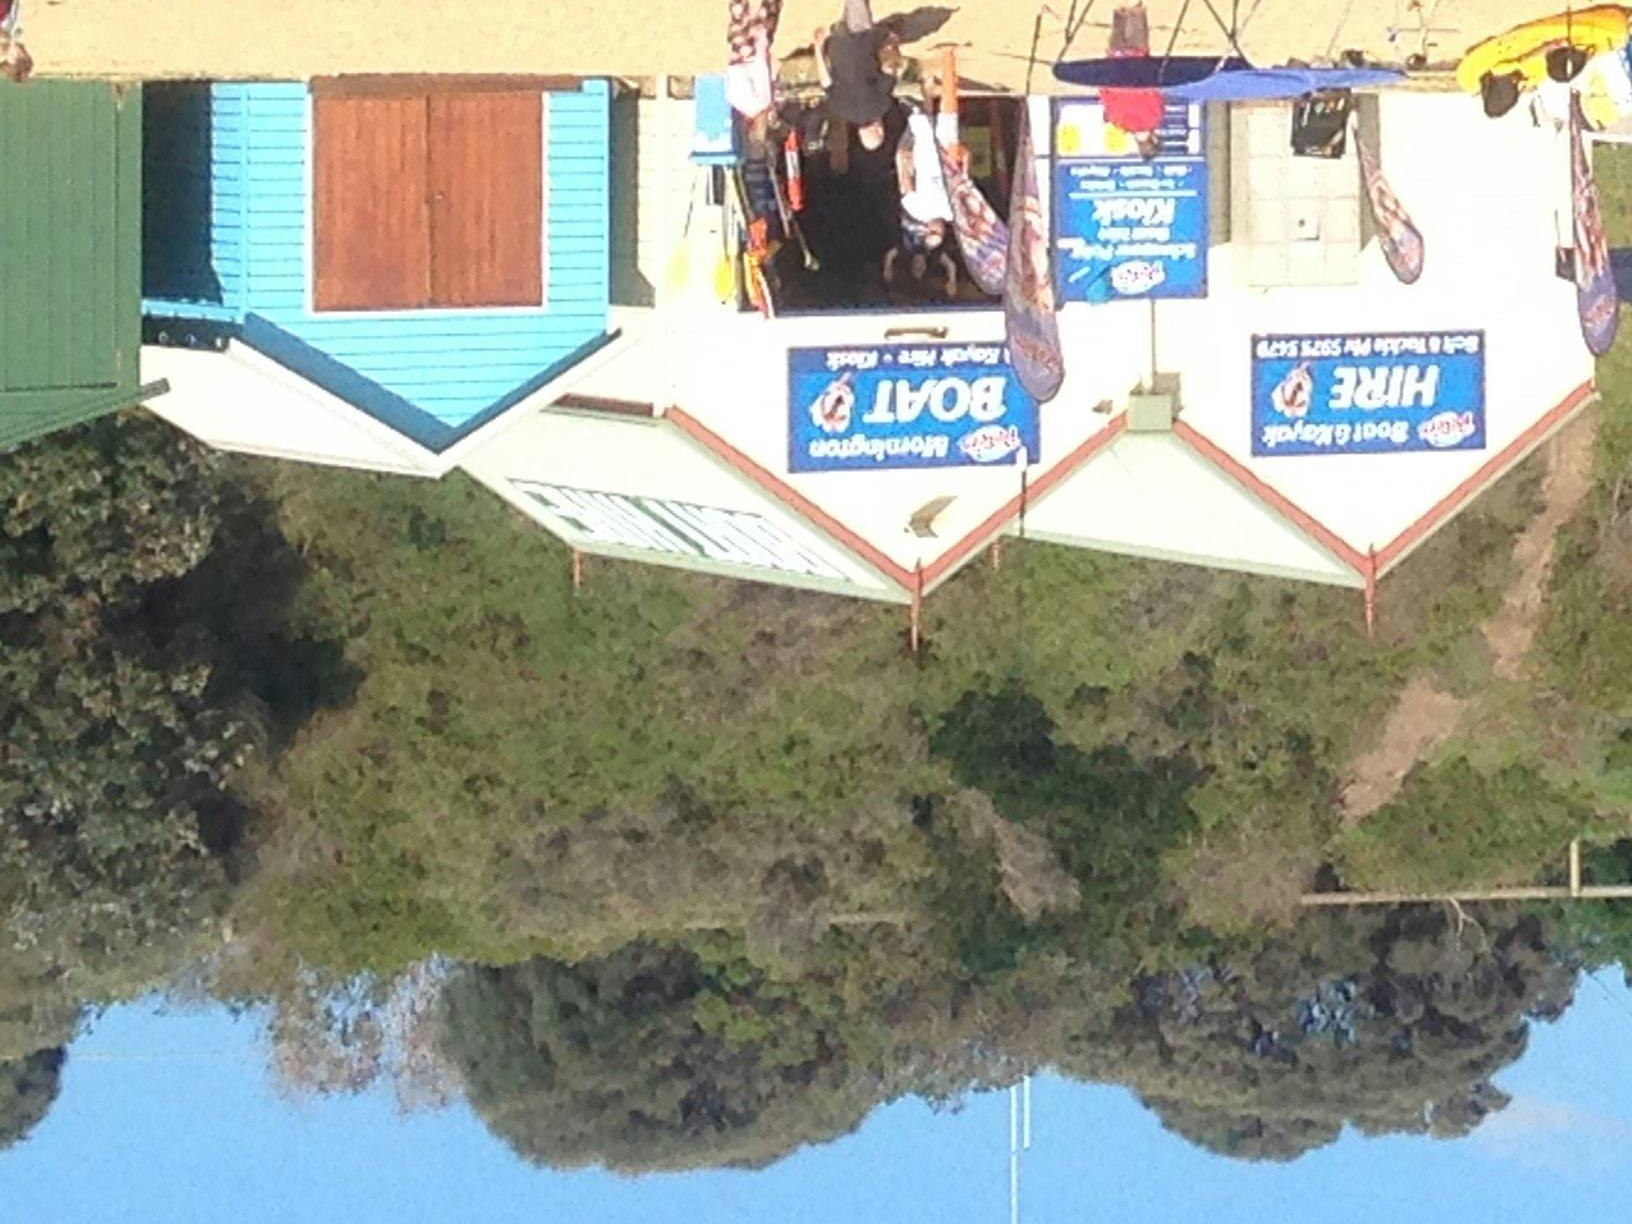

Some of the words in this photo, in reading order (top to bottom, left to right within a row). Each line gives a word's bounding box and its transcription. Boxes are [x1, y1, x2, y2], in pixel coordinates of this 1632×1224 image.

[1092, 199, 1175, 227] Kiosk
[941, 344, 999, 367] Kayak
[1374, 337, 1427, 354] Tackle
[826, 351, 877, 370] Kiosk
[899, 350, 936, 367] Hire
[863, 376, 1006, 423] BOAT
[1329, 365, 1439, 410] HIRE
[1262, 420, 1333, 447] Kayak
[1353, 421, 1409, 444] Boat
[809, 433, 949, 461] Mornington
